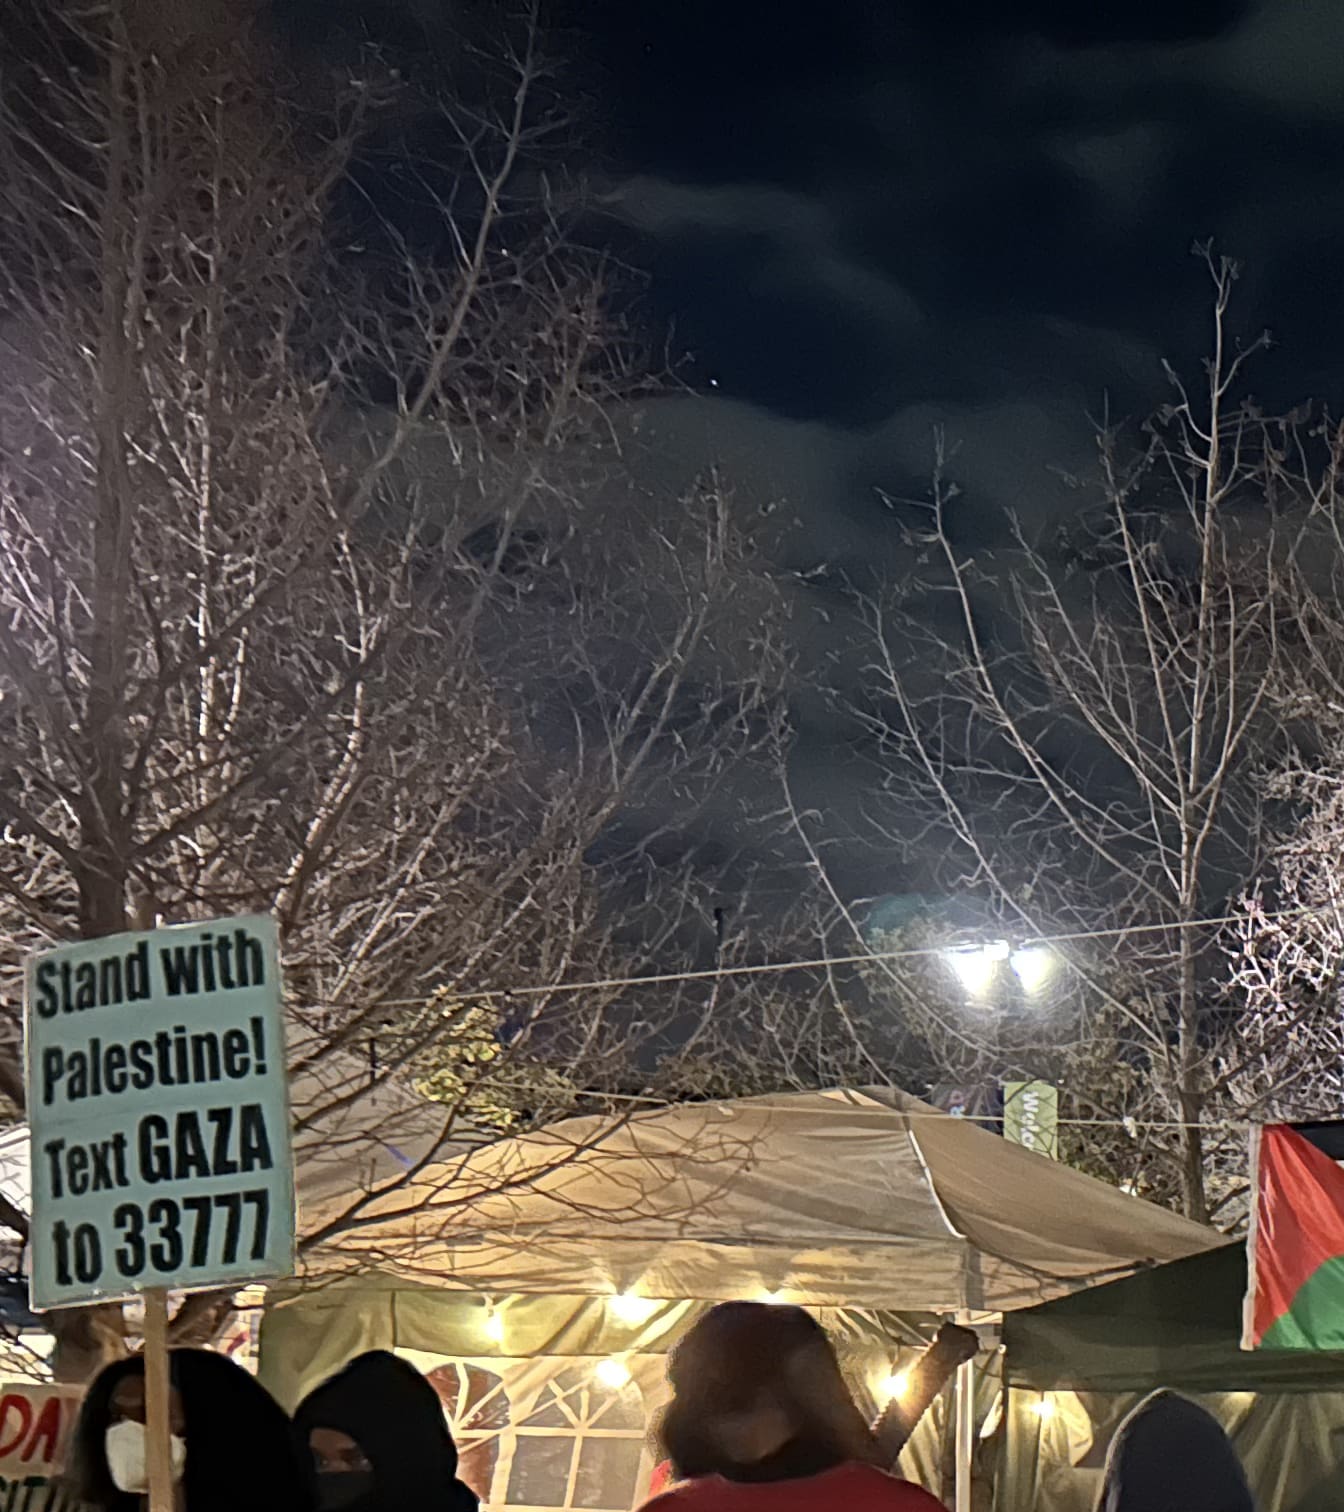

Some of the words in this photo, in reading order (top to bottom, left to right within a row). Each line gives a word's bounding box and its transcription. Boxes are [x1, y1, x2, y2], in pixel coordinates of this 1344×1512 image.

[36, 941, 151, 1018] Stand
[160, 929, 265, 996] with
[42, 1016, 268, 1106] Palestine!
[44, 1132, 130, 1198] Text
[138, 1103, 273, 1184] GAZA
[1020, 1091, 1040, 1150] Welc
[52, 1220, 102, 1285] to
[113, 1188, 270, 1276] 33777
